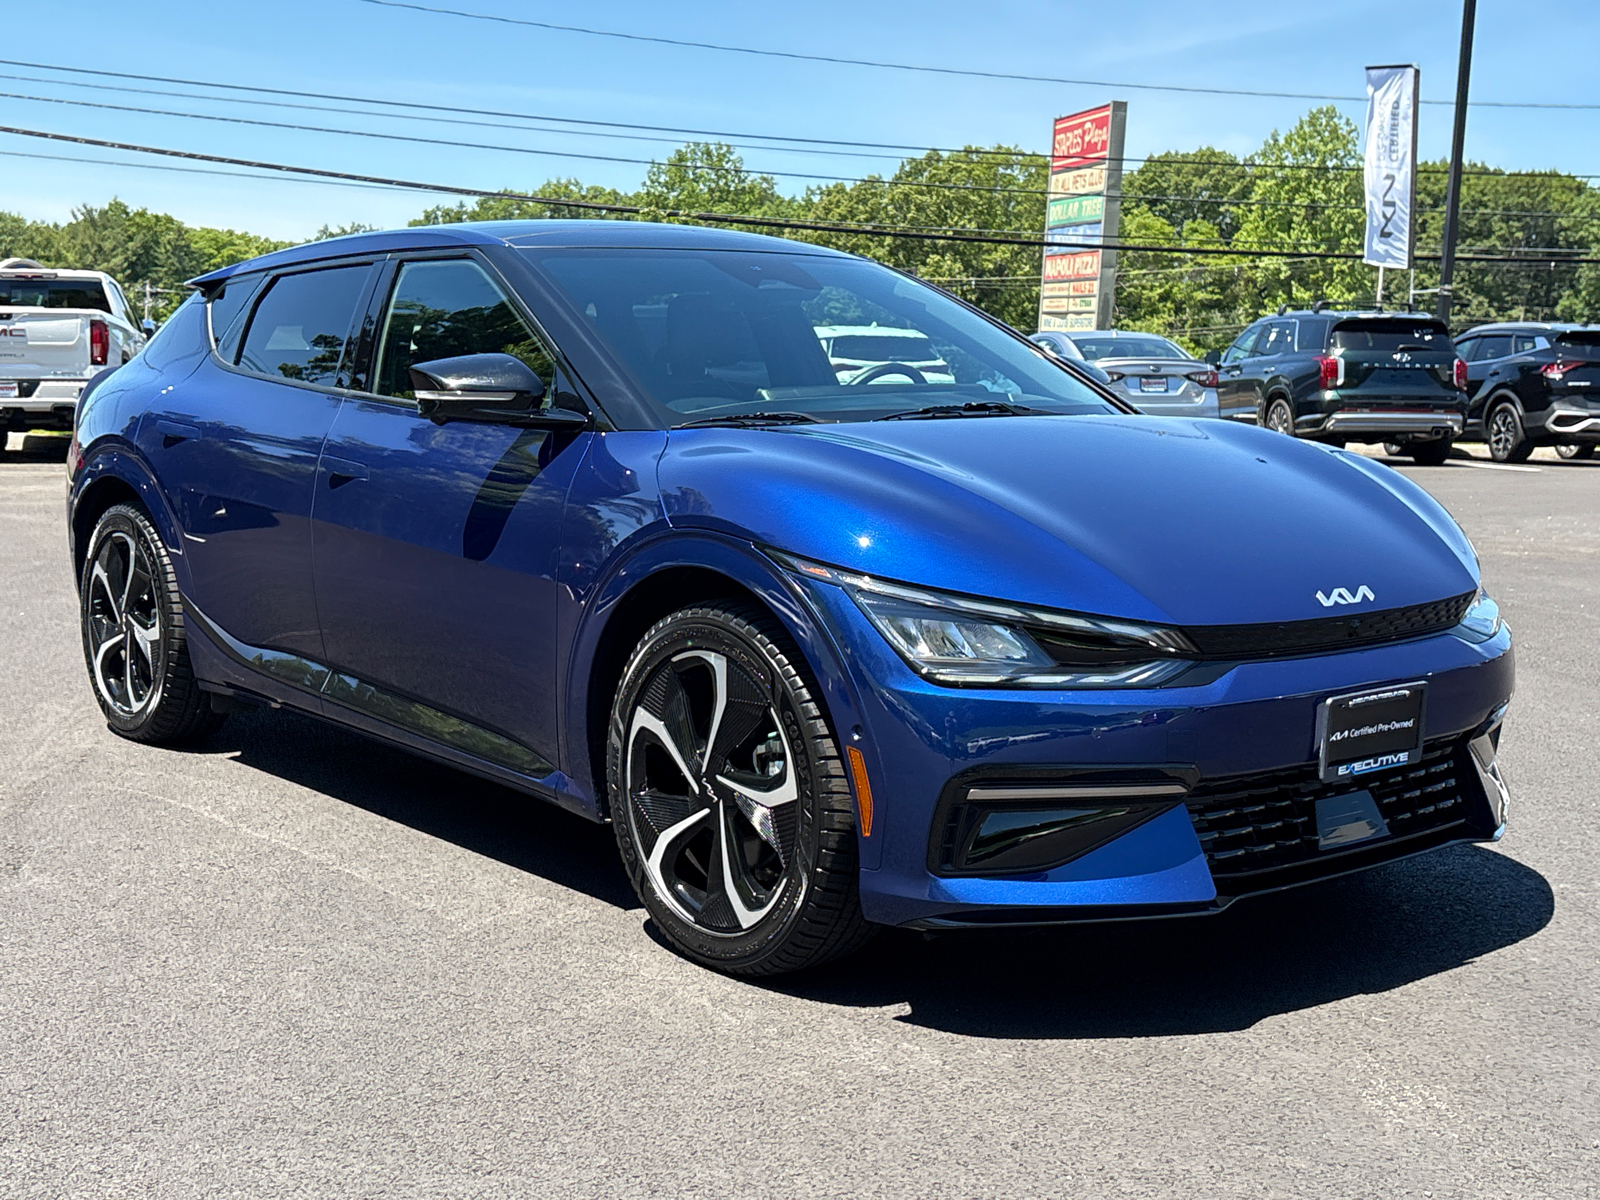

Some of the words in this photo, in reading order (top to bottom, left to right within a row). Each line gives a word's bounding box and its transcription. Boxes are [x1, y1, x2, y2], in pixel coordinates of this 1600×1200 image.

[1054, 127, 1083, 157] STAPLES
[1083, 121, 1108, 151] Plaza
[1072, 173, 1087, 190] PETS
[1049, 201, 1079, 222] DOLLAR
[1081, 197, 1102, 217] TREE
[1045, 257, 1074, 277] NAPOLI
[1074, 255, 1098, 275] PIZZA
[1072, 282, 1087, 293] NAILS
[1349, 725, 1377, 738] Certified
[1377, 719, 1414, 732] Pre-Owned
[1337, 751, 1410, 776] EXECUTIVE
